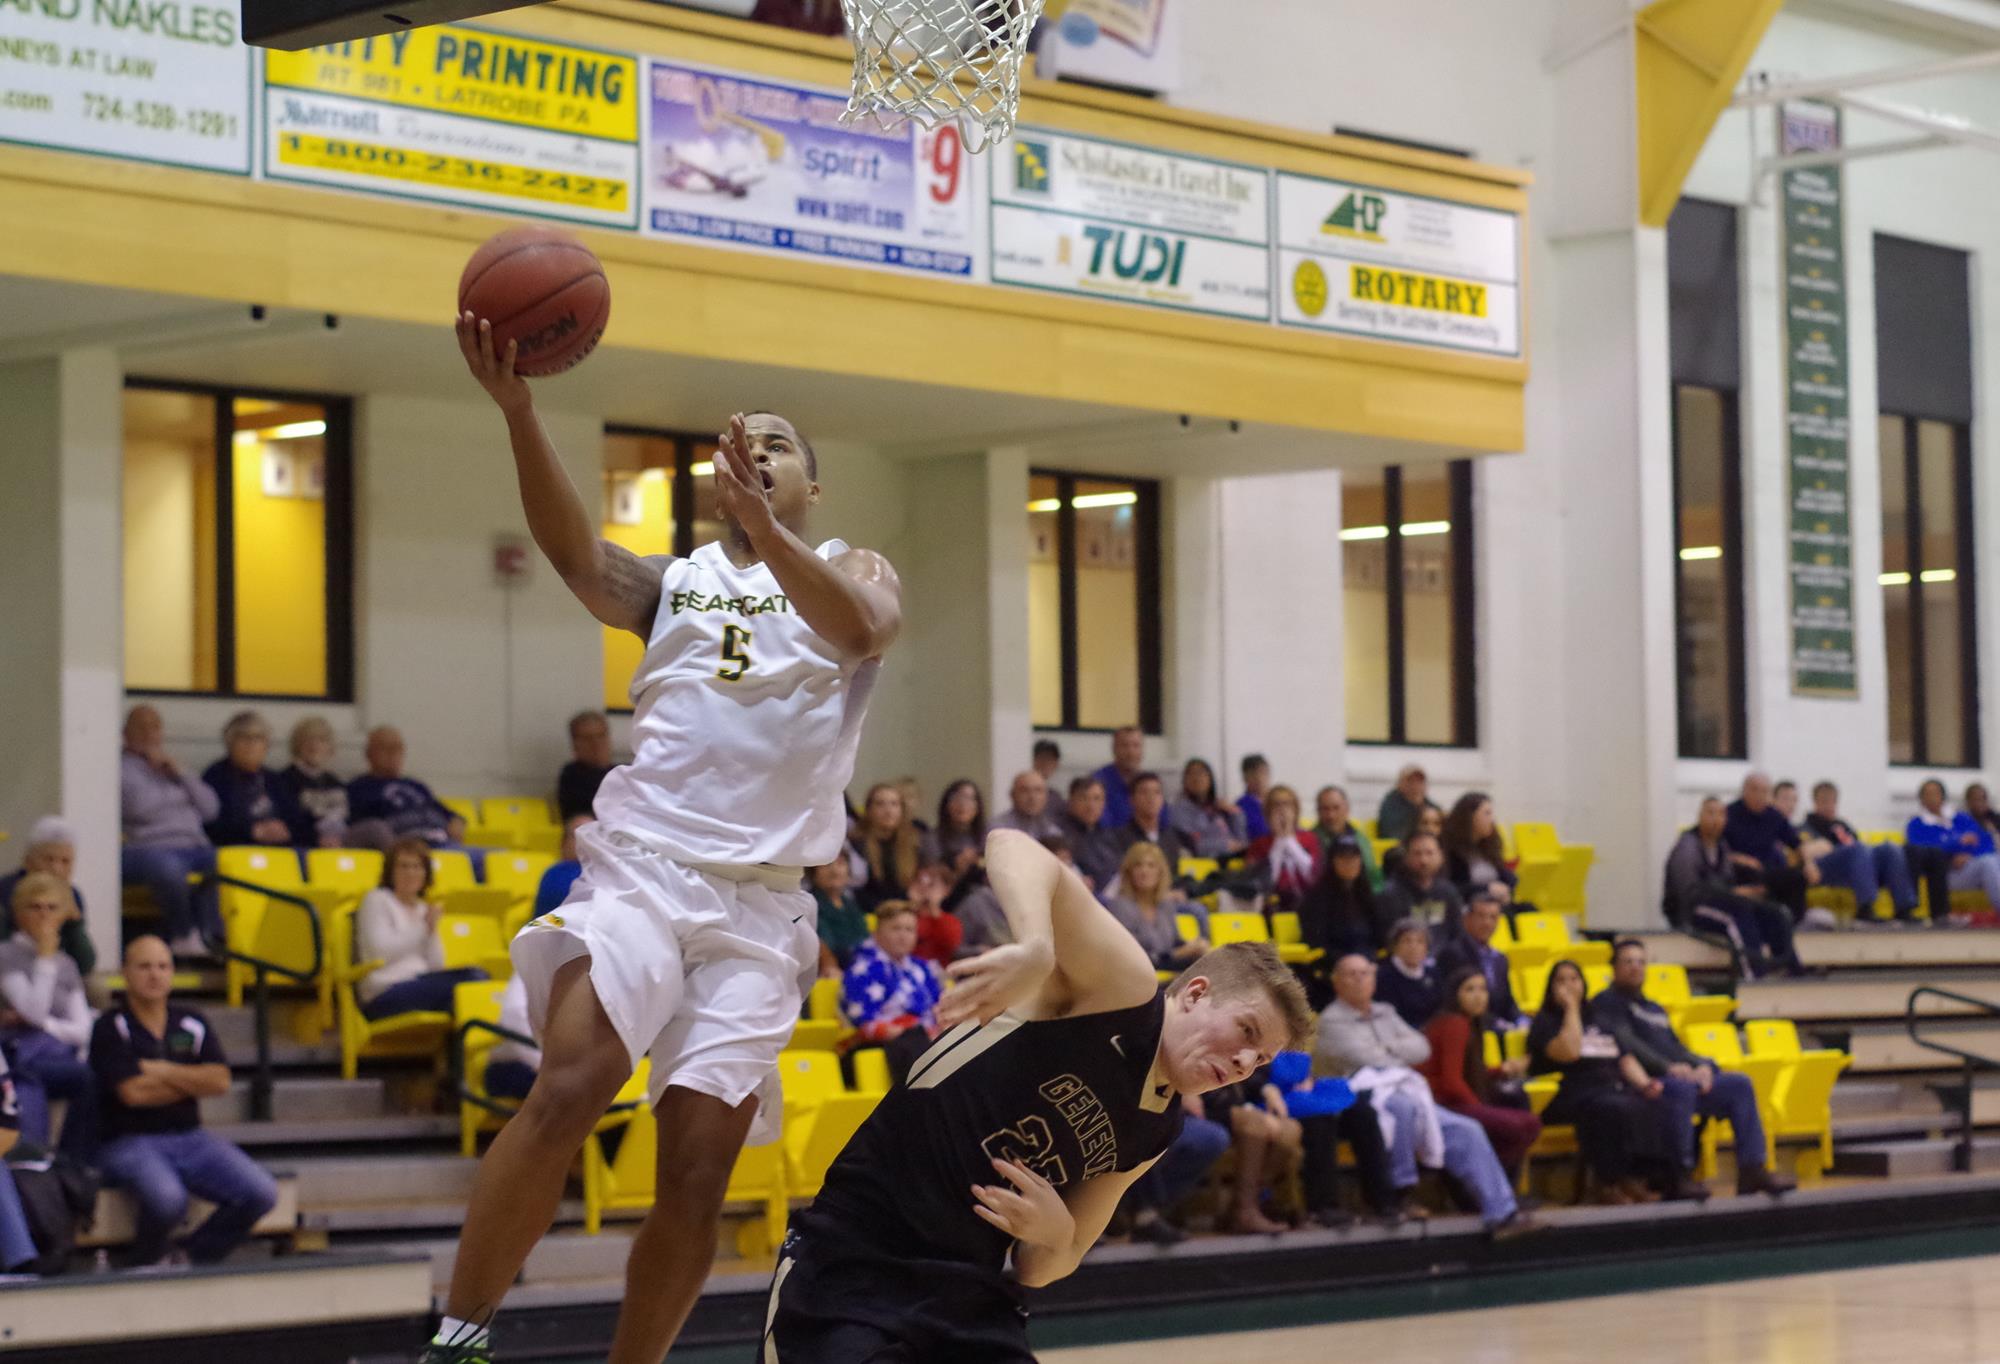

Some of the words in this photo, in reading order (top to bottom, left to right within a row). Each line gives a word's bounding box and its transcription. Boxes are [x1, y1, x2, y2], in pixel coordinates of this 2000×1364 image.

[92, 0, 236, 47] NAKLES
[70, 47, 97, 70] AT
[103, 52, 157, 79] LAW
[434, 35, 625, 103] PRINTING
[434, 85, 545, 121] LATROBE
[560, 105, 591, 126] PA
[284, 134, 624, 199] 1-800-236-2427
[805, 146, 881, 181] spirit
[1083, 225, 1186, 287] TUDI
[1354, 266, 1484, 316] ROTARY
[716, 623, 752, 682] 5
